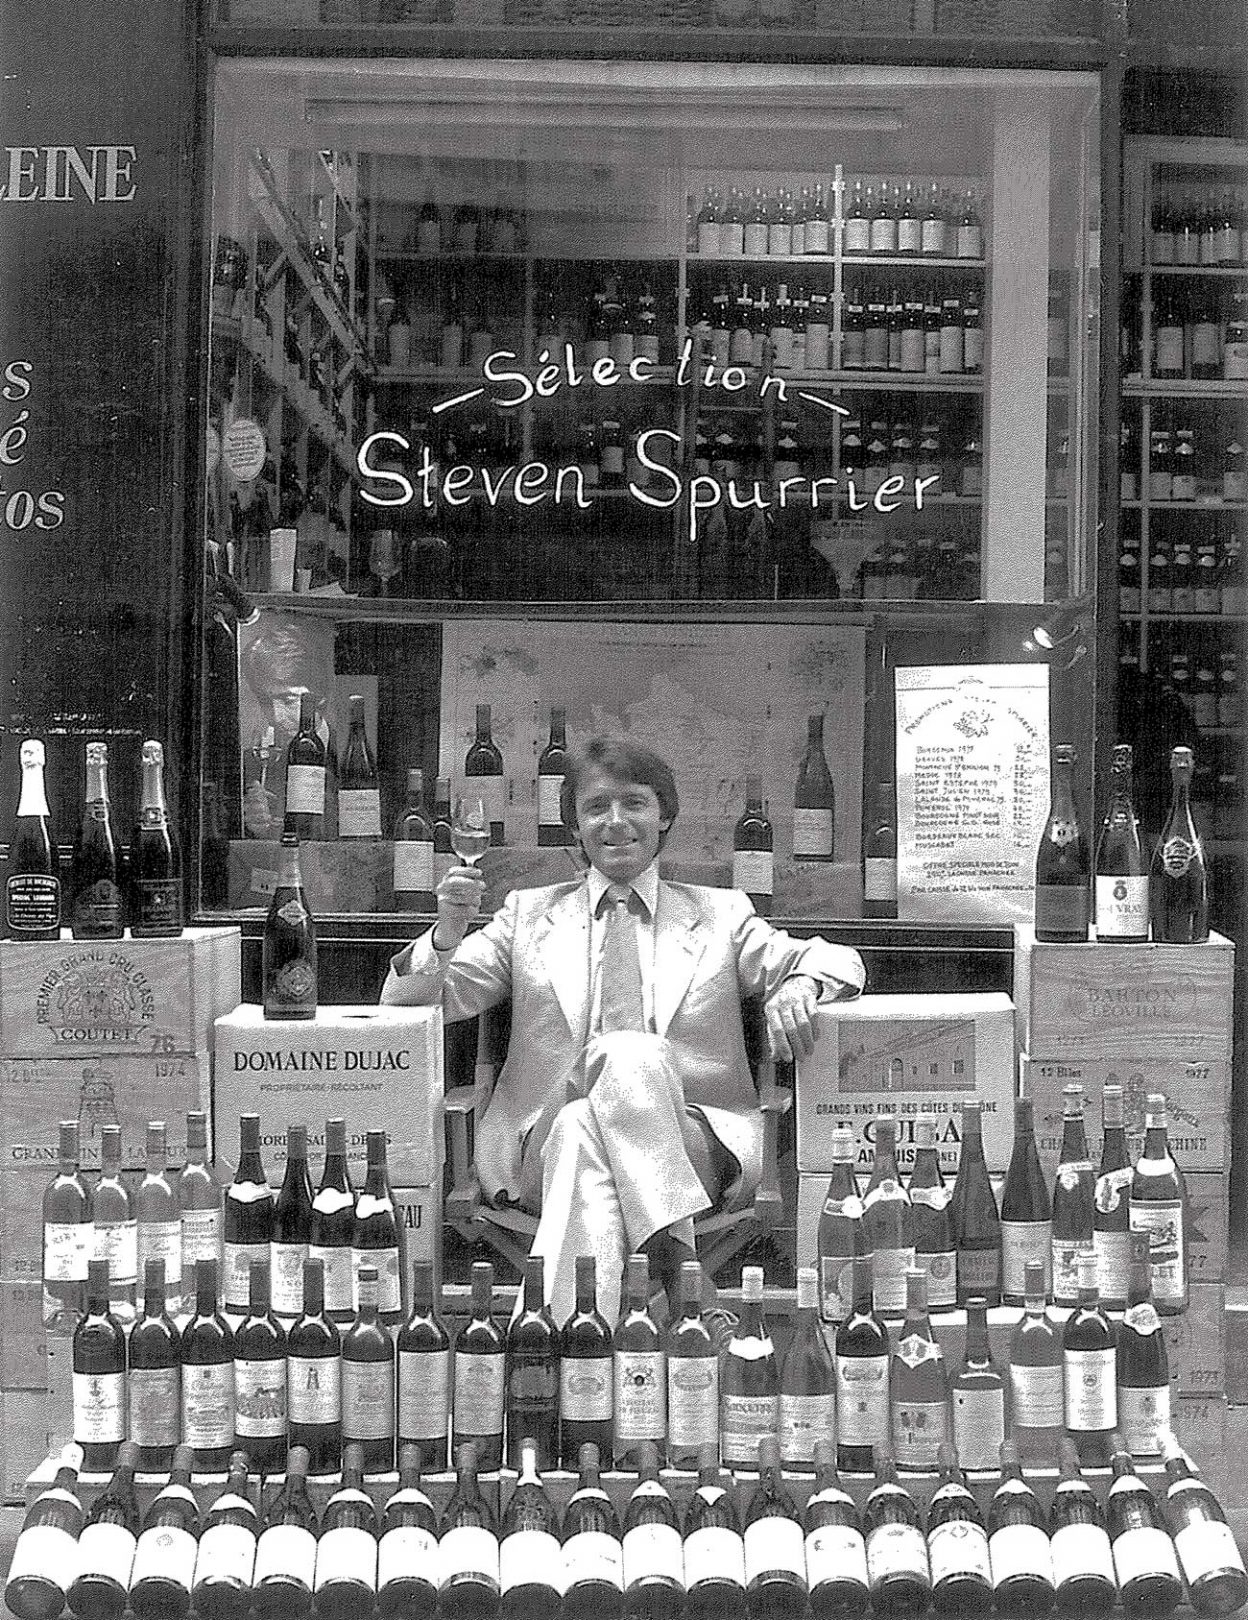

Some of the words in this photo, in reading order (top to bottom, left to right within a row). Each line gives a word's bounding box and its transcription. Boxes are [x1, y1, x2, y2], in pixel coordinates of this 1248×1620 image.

[0, 145, 138, 204] EINE
[483, 338, 788, 407] Sélection
[355, 431, 592, 508] Steven
[629, 429, 941, 542] Spurrier
[0, 489, 65, 531] os
[61, 1028, 132, 1041] COUTET
[234, 1051, 337, 1071] DOMAINE
[344, 1051, 410, 1071] DUJAC
[816, 1103, 850, 1115] GRANDS
[854, 1103, 875, 1114] VINS
[877, 1103, 896, 1114] FINS
[901, 1103, 917, 1114] DES
